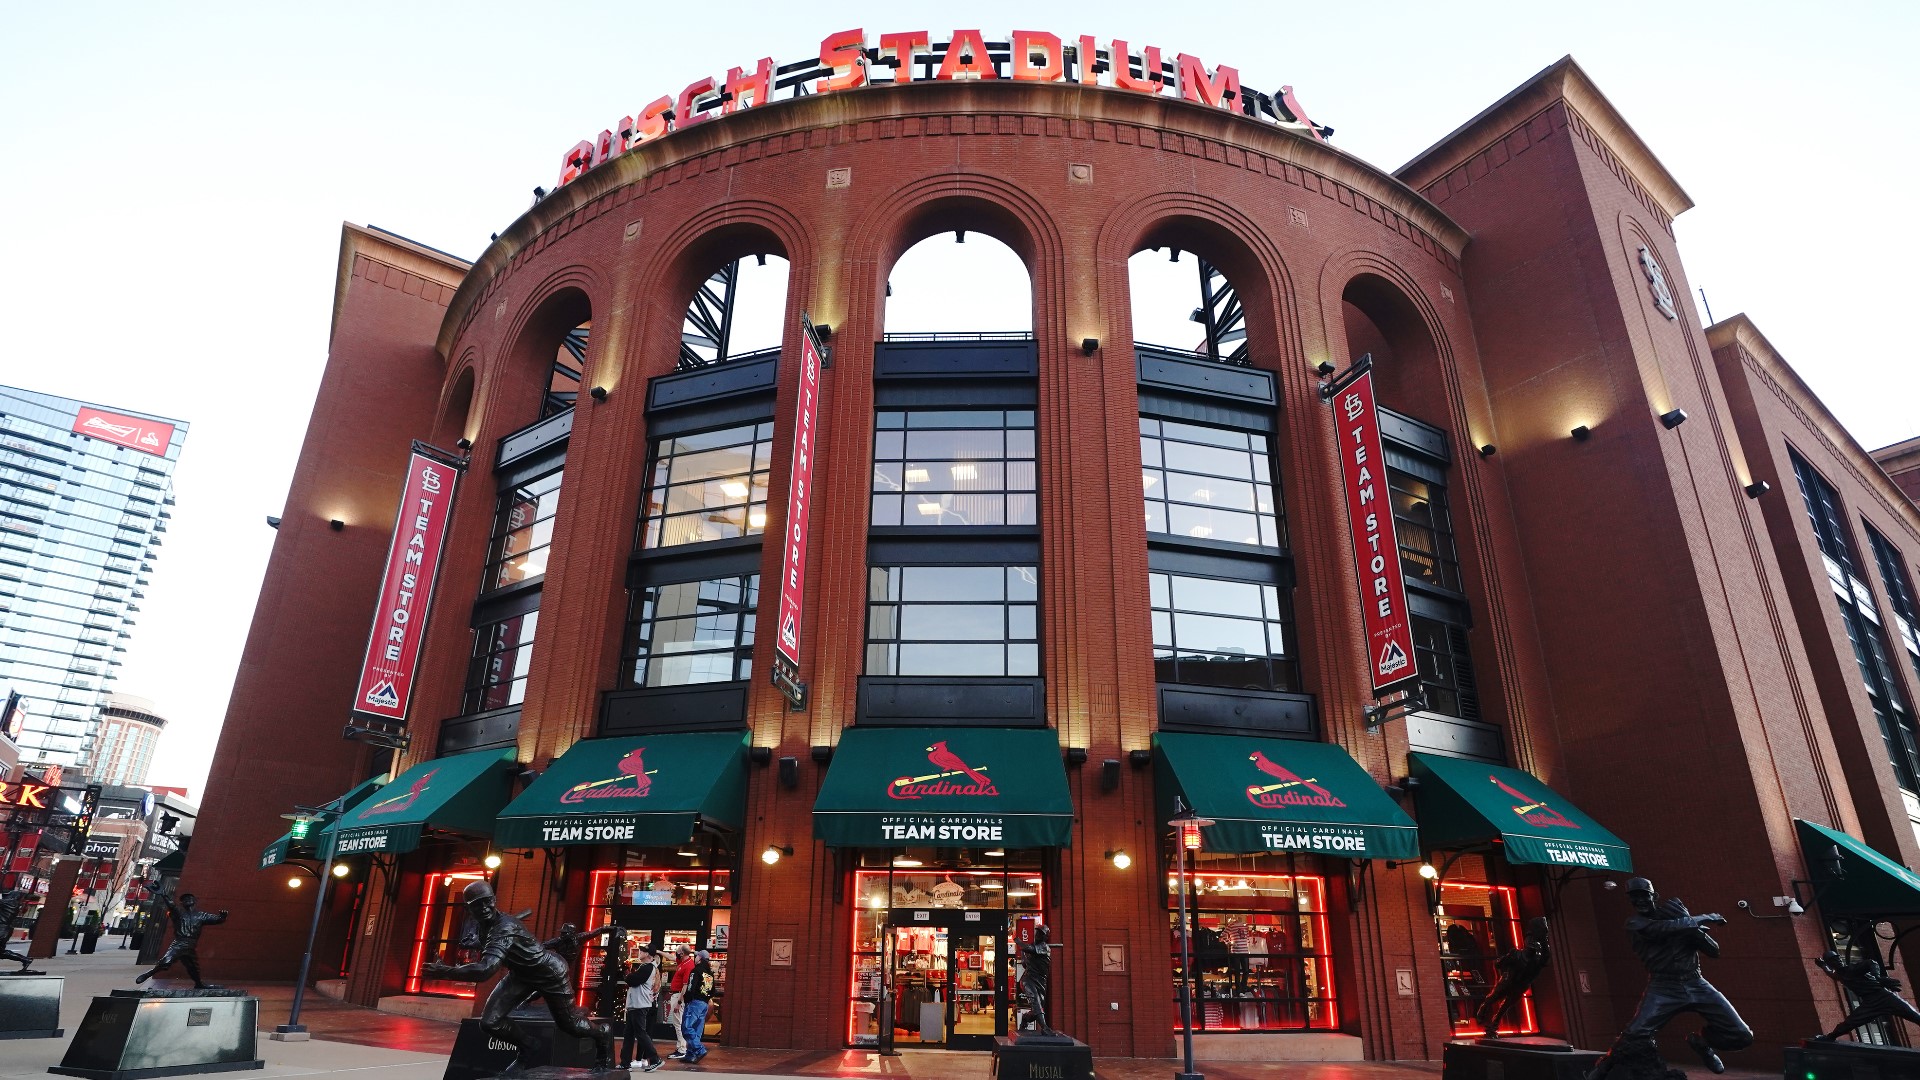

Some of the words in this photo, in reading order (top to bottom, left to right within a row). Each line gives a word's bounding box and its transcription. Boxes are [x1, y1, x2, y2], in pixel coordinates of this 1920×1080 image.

[556, 56, 778, 189] BUSCH
[816, 27, 1246, 116] STADIUM
[800, 387, 812, 472] TEAM
[1352, 425, 1376, 507] TEAM
[1365, 512, 1392, 619] STORE
[405, 498, 433, 566] TEAM
[790, 479, 804, 590] STORE
[384, 573, 416, 662] STORE
[372, 665, 405, 678] PRESENTED
[1380, 658, 1406, 673] Majestic
[367, 695, 397, 707] Majestic
[560, 781, 650, 804] Cardinals
[887, 776, 1000, 800] Cardinals
[1246, 785, 1347, 809] Cardinals
[587, 817, 636, 825] CARDINALS
[940, 817, 1003, 825] CARDINALS
[542, 826, 583, 841] TEAM
[584, 825, 635, 841] STORE
[881, 825, 936, 840] TEAM
[938, 825, 1003, 841] STORE
[1261, 825, 1308, 833] OFFICIAL
[1312, 827, 1364, 836] CARDINALS
[338, 838, 360, 852] TEAM
[358, 835, 388, 850] STORE
[1262, 833, 1311, 849] TEAM
[1313, 835, 1366, 851] STORE
[1544, 842, 1573, 850] OFFICIAL
[1574, 845, 1605, 854] CARDINALS
[1546, 848, 1580, 864] TEAM
[1579, 851, 1610, 867] STORE
